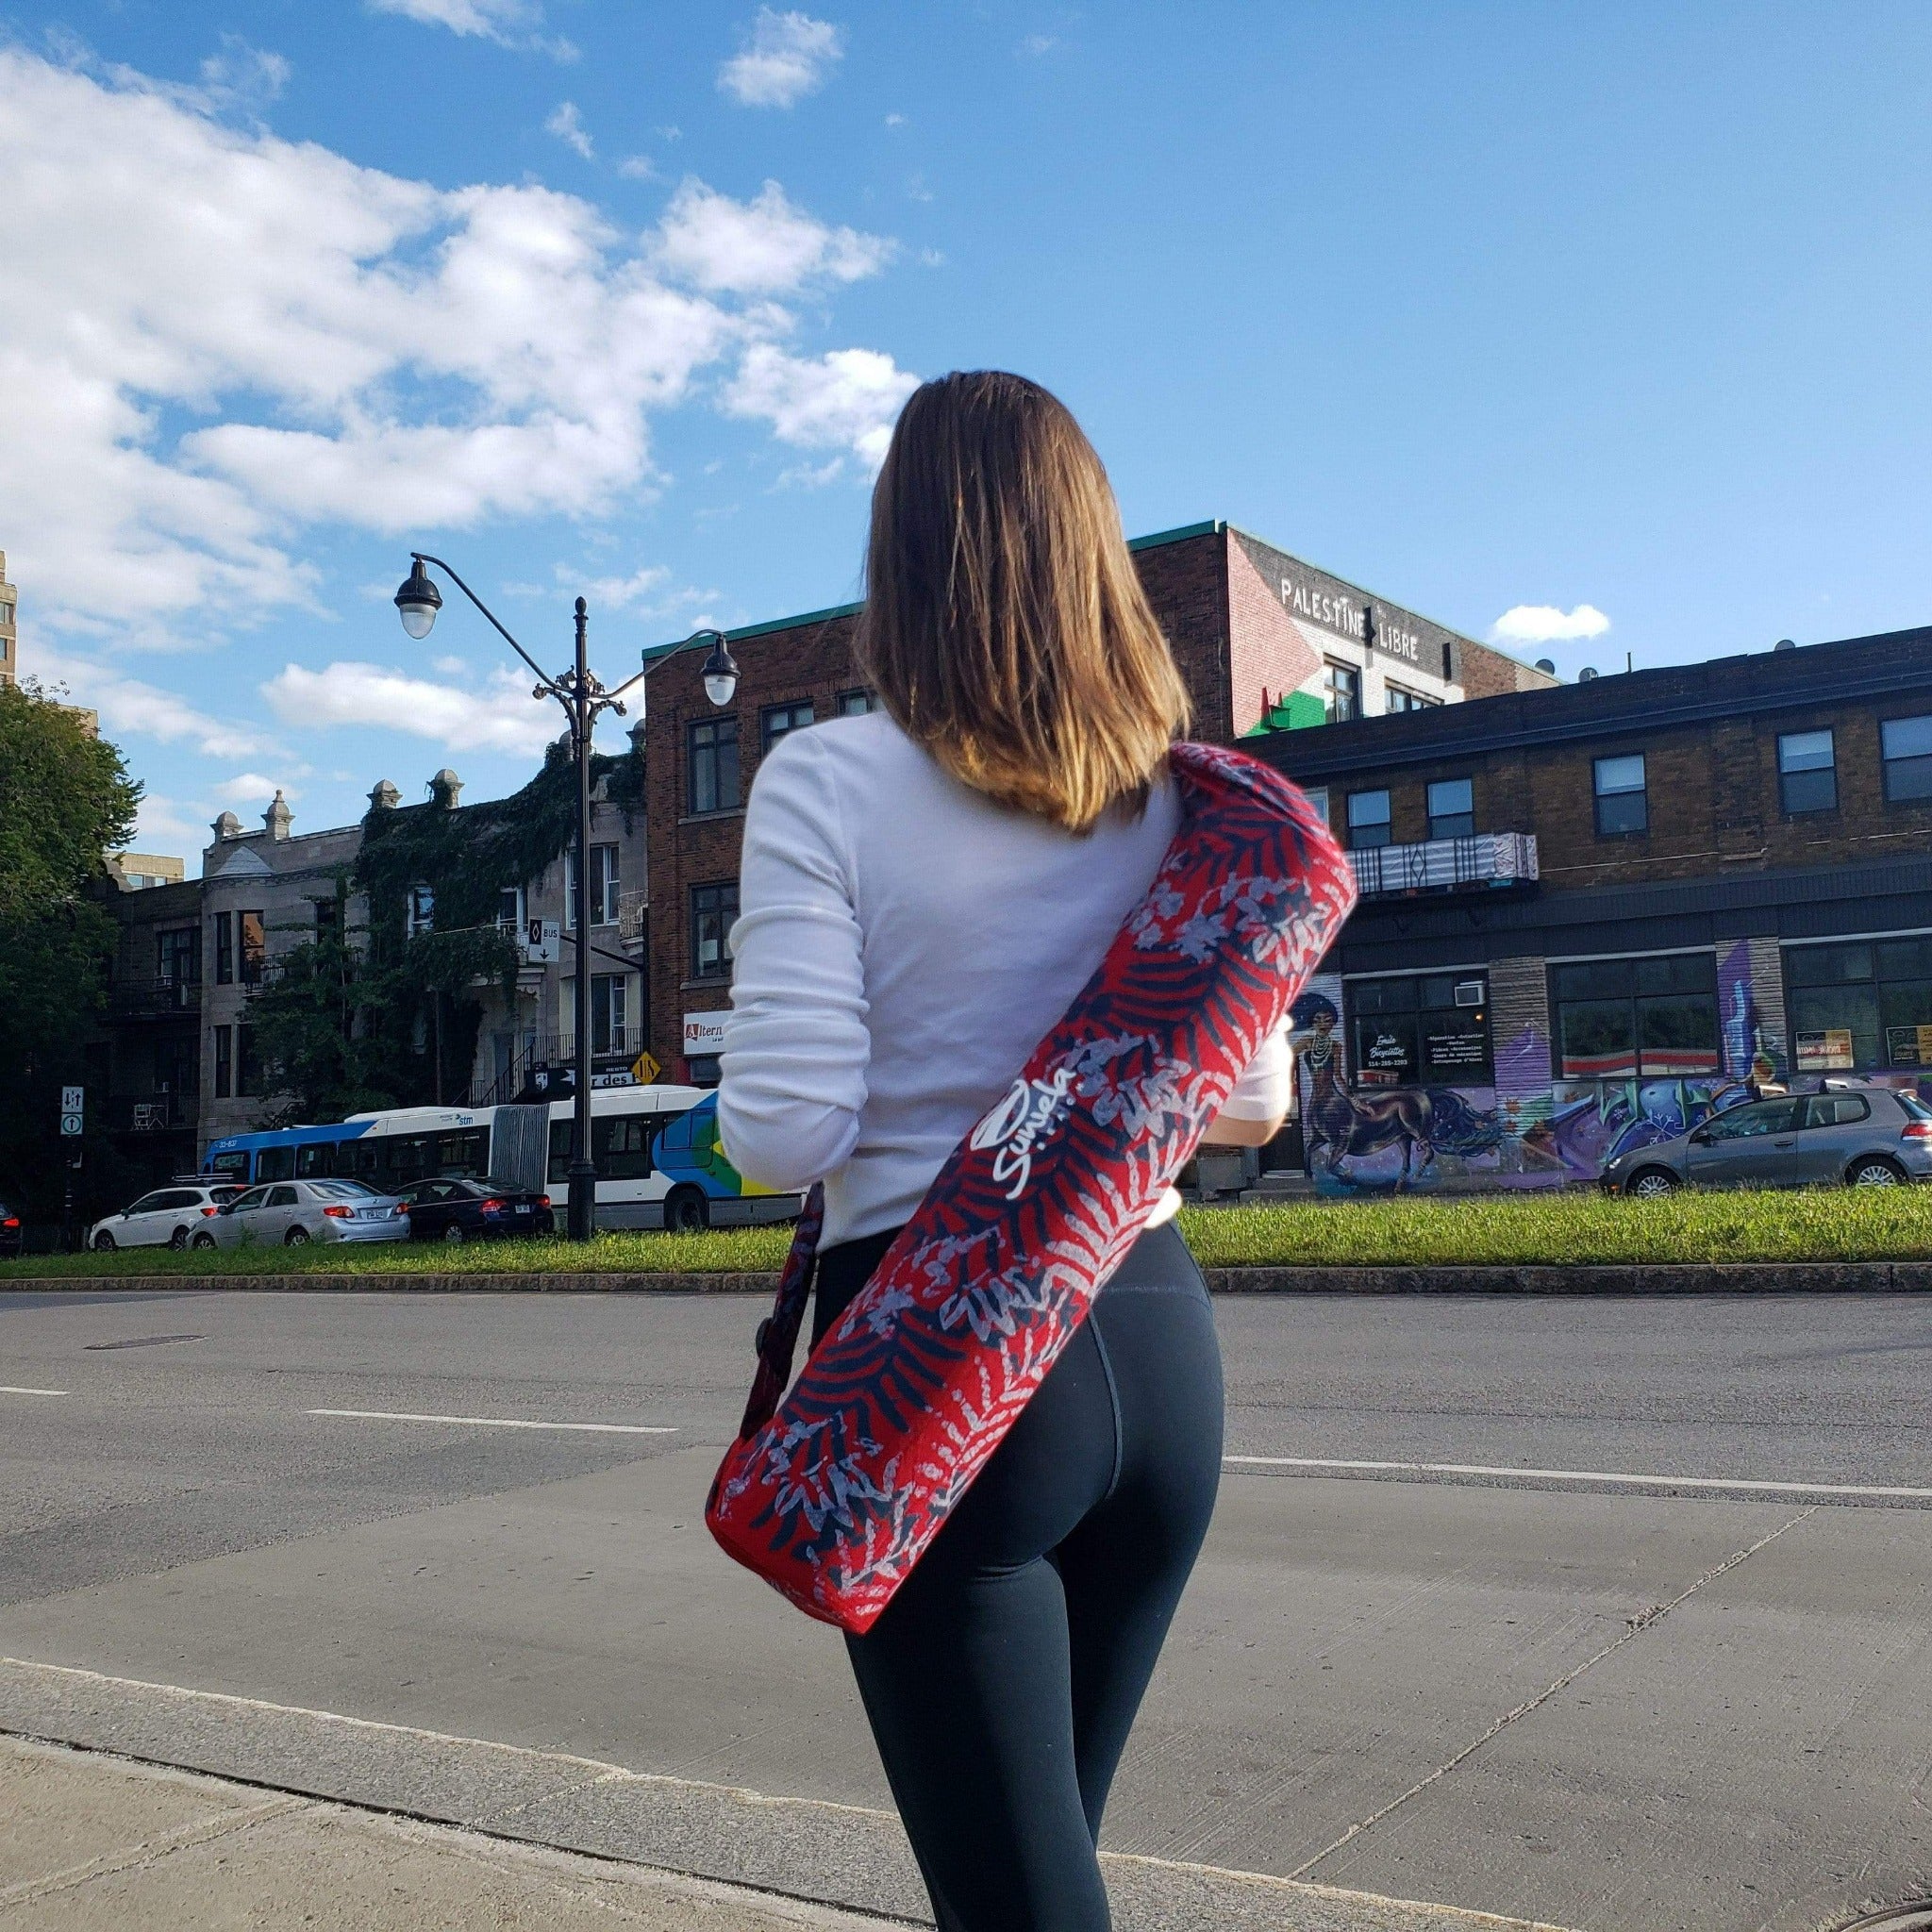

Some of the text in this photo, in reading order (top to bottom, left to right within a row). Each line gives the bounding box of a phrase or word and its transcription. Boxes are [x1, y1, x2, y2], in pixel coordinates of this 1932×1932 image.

[1281, 578, 1419, 661] PALESTINE LIBRE
[544, 929, 558, 938] BUS
[602, 1074, 627, 1087] des
[458, 1116, 474, 1125] stm
